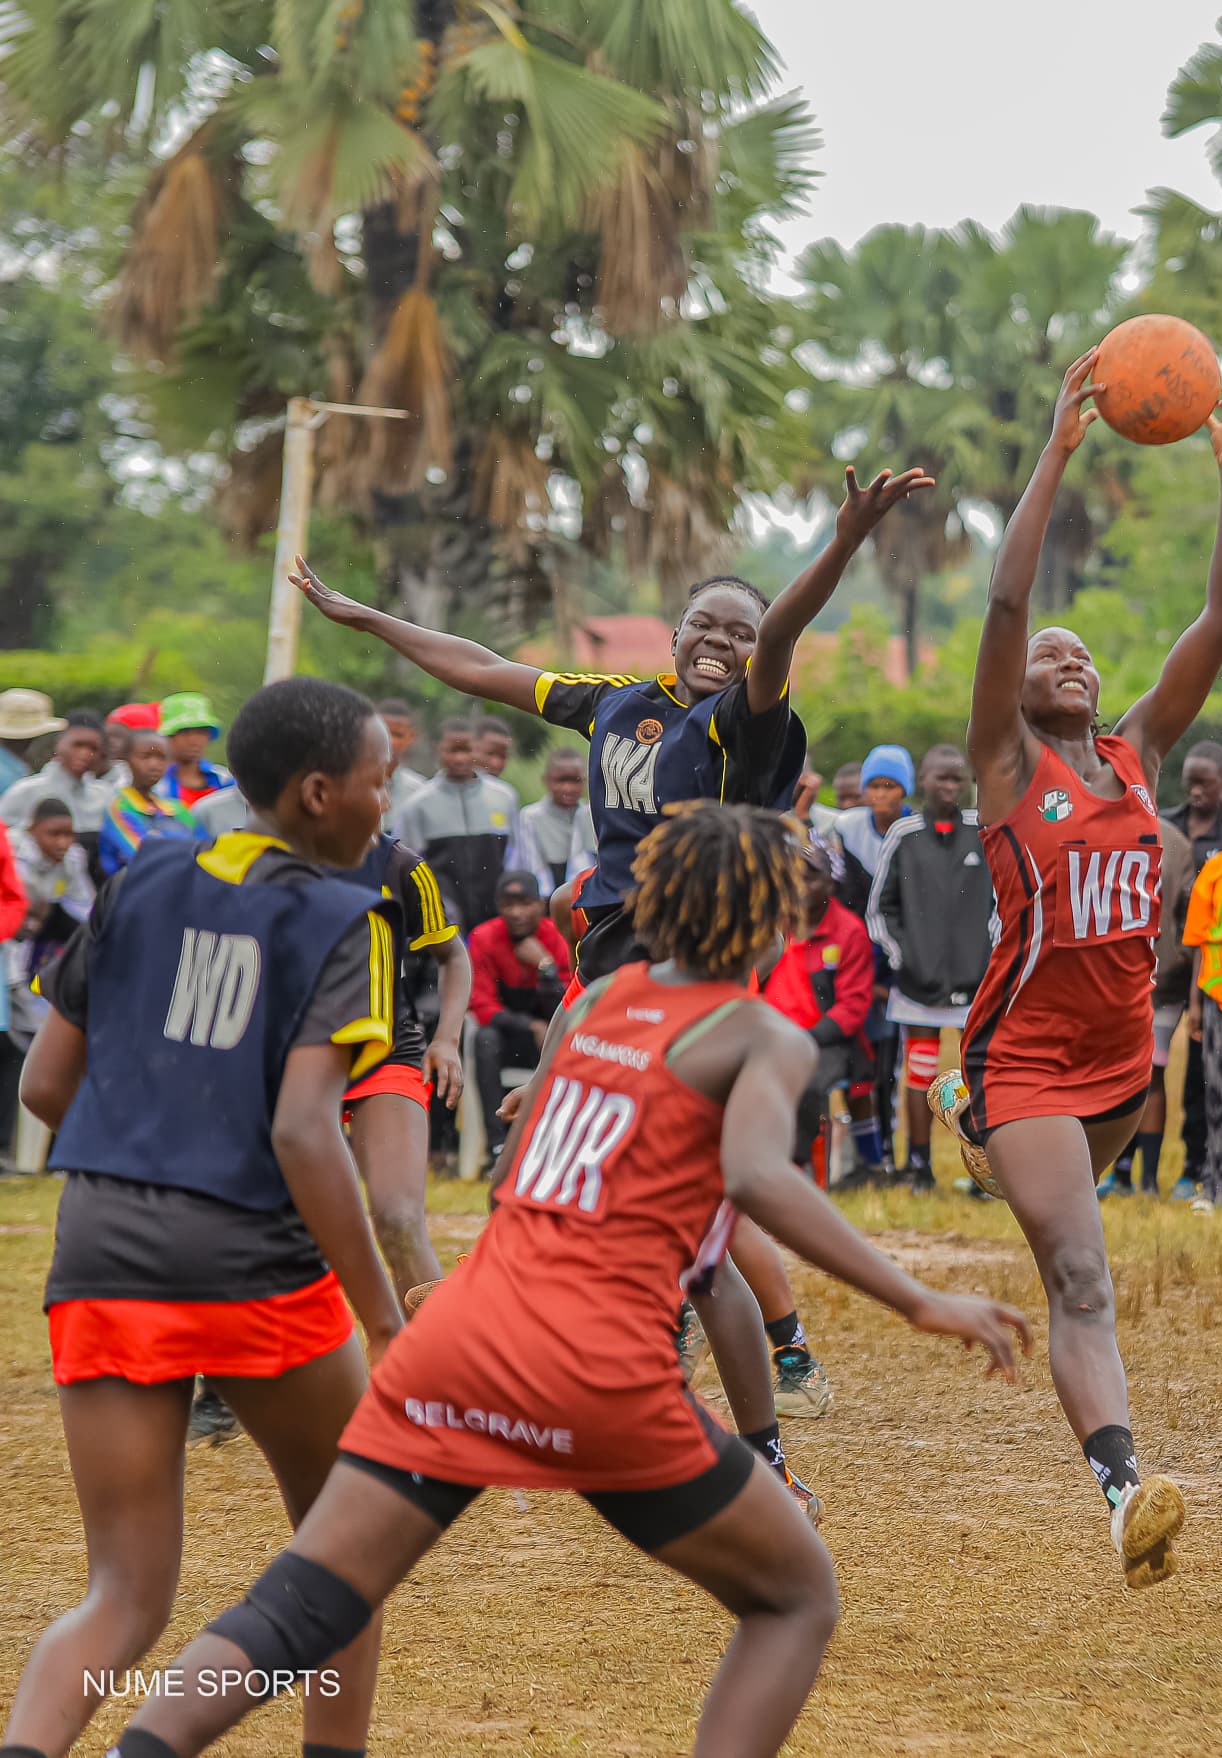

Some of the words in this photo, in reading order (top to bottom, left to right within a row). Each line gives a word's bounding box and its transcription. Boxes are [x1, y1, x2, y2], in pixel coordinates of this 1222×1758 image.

[600, 731, 663, 815] WA
[1068, 850, 1150, 940] WD
[163, 926, 262, 1051] WD
[514, 1075, 636, 1214] WR
[404, 1396, 574, 1455] BELGRAVE
